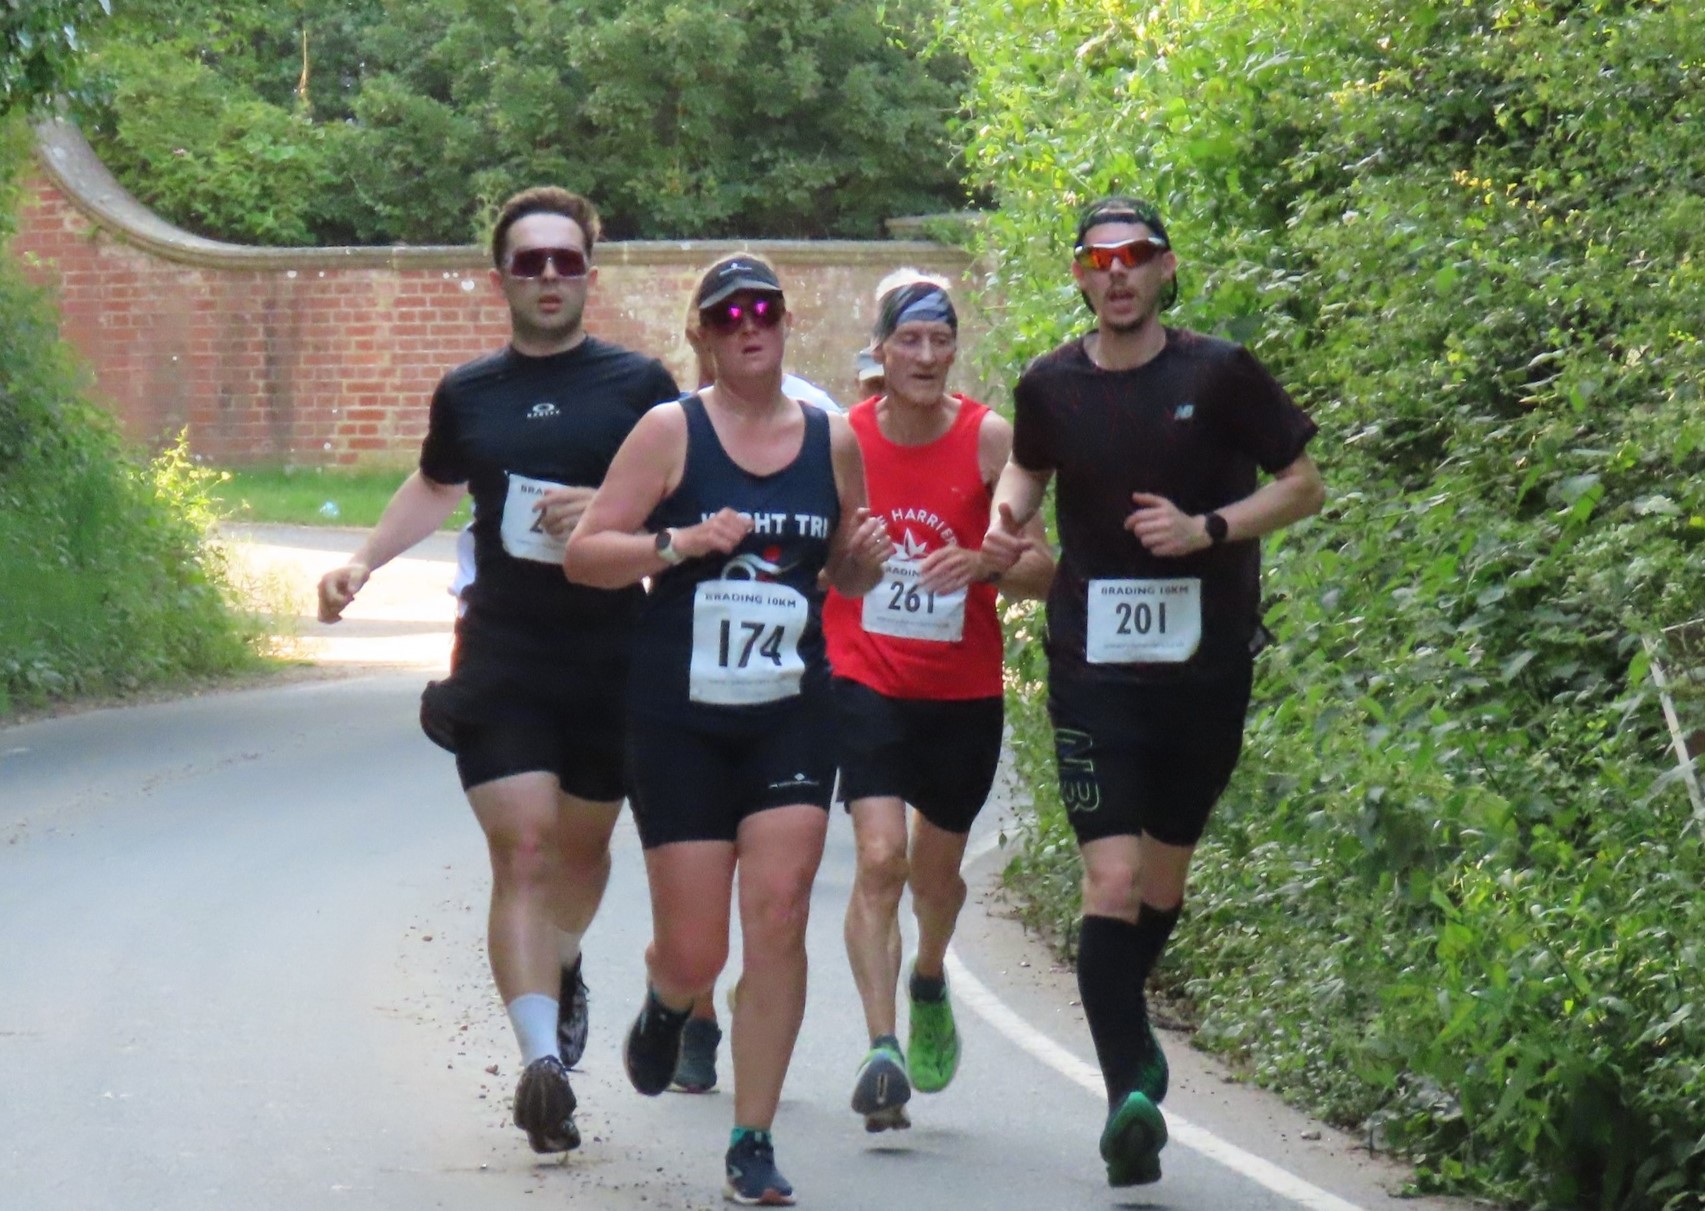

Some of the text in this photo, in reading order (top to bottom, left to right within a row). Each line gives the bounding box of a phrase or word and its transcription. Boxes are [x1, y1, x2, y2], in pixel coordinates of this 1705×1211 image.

[794, 513, 828, 539] TRI
[767, 598, 796, 608] 10KM
[887, 580, 935, 614] 261
[1115, 601, 1166, 635] 201
[718, 619, 786, 668] 174
